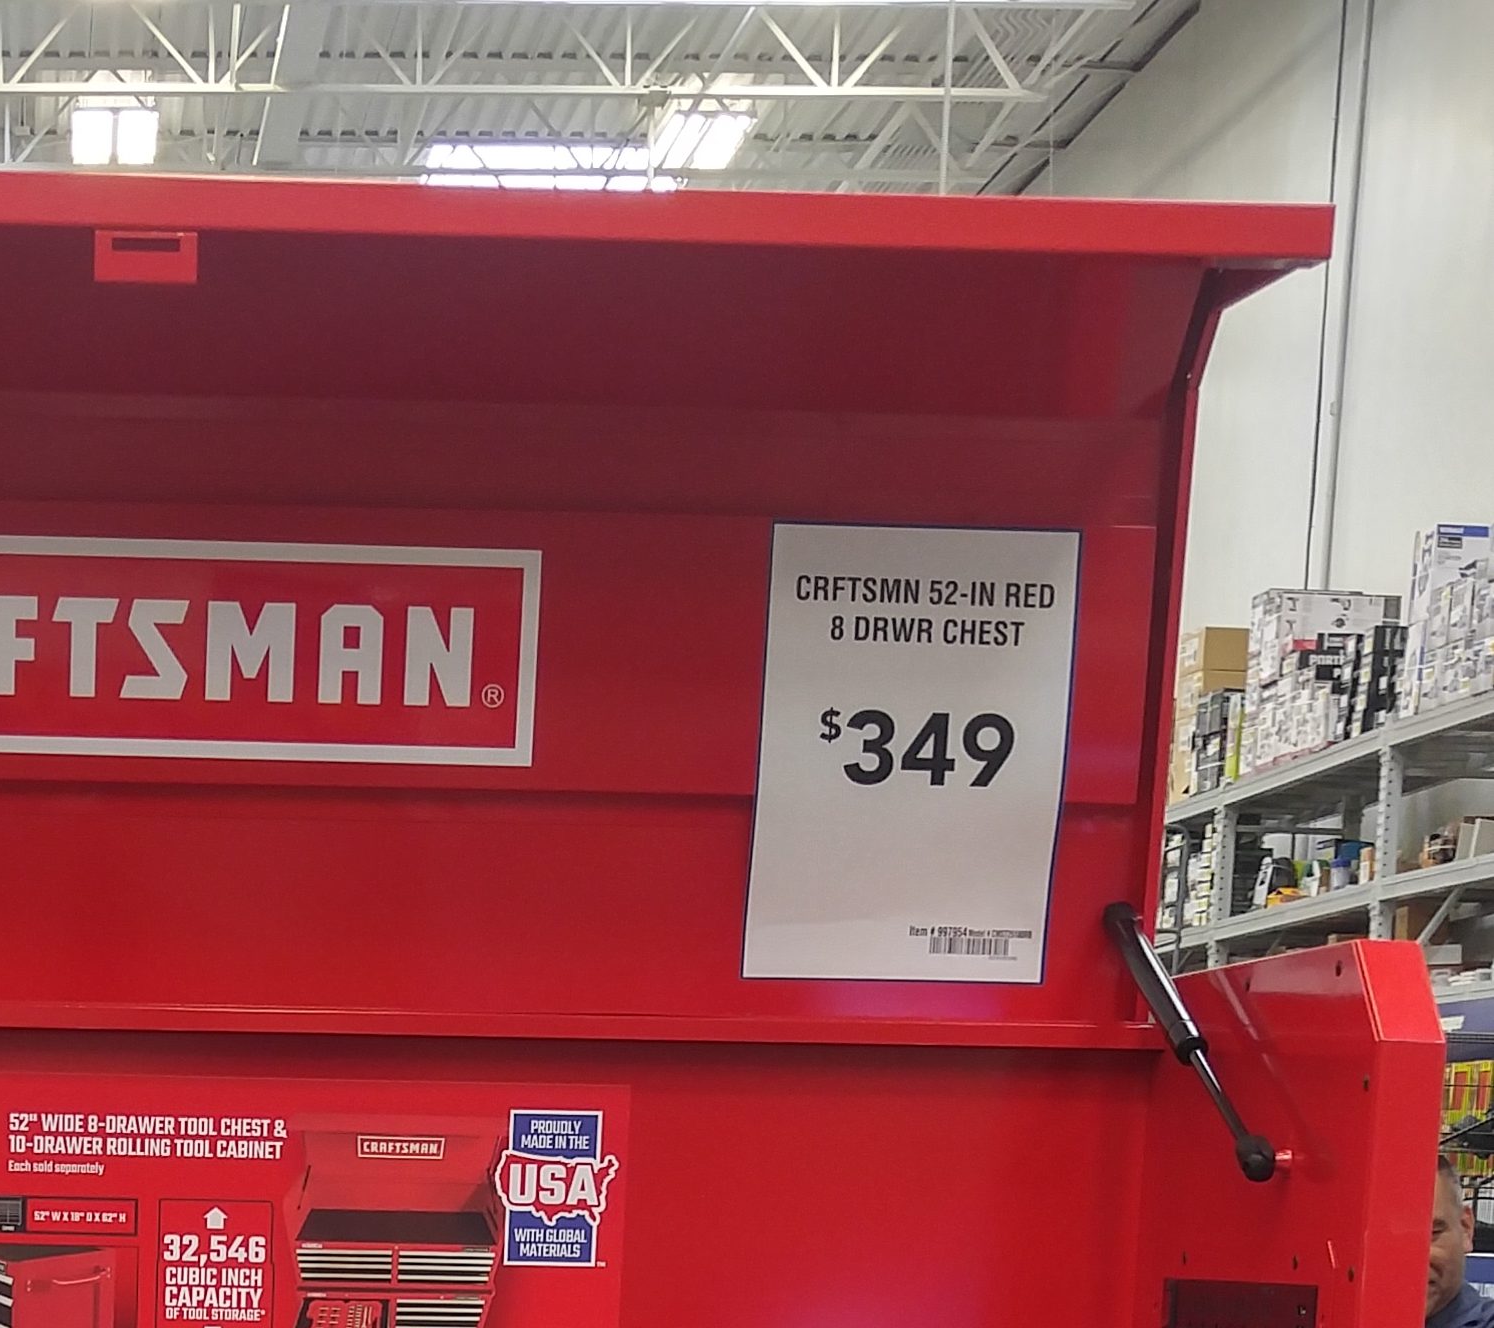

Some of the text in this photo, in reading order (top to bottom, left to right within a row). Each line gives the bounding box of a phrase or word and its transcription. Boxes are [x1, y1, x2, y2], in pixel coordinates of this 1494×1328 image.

[796, 575, 1055, 609] CRFTSMN 52-IN RED
[830, 615, 1025, 647] 8 DRWR CHEST
[819, 707, 1015, 788] $349
[909, 925, 928, 937] Item
[9, 1113, 288, 1138] 52" WIDE 8-DRAWER TOOL CHEST &
[530, 1119, 582, 1135] PROUDLY
[8, 1135, 284, 1160] 10-DRAWER ROLLING TOOL CABINET
[363, 1141, 439, 1155] CRAFTSMAN
[521, 1134, 590, 1150] MADE IN THE
[8, 1160, 105, 1176] Each sold separately
[508, 1163, 599, 1206] USA
[514, 1227, 587, 1244] WITH GLOBAL
[163, 1234, 266, 1267] 32,546
[519, 1243, 581, 1258] MATERIALS
[165, 1266, 263, 1287] CUBIC INCH
[165, 1286, 263, 1308] CAPACITY
[166, 1307, 209, 1320] OF TOOL
